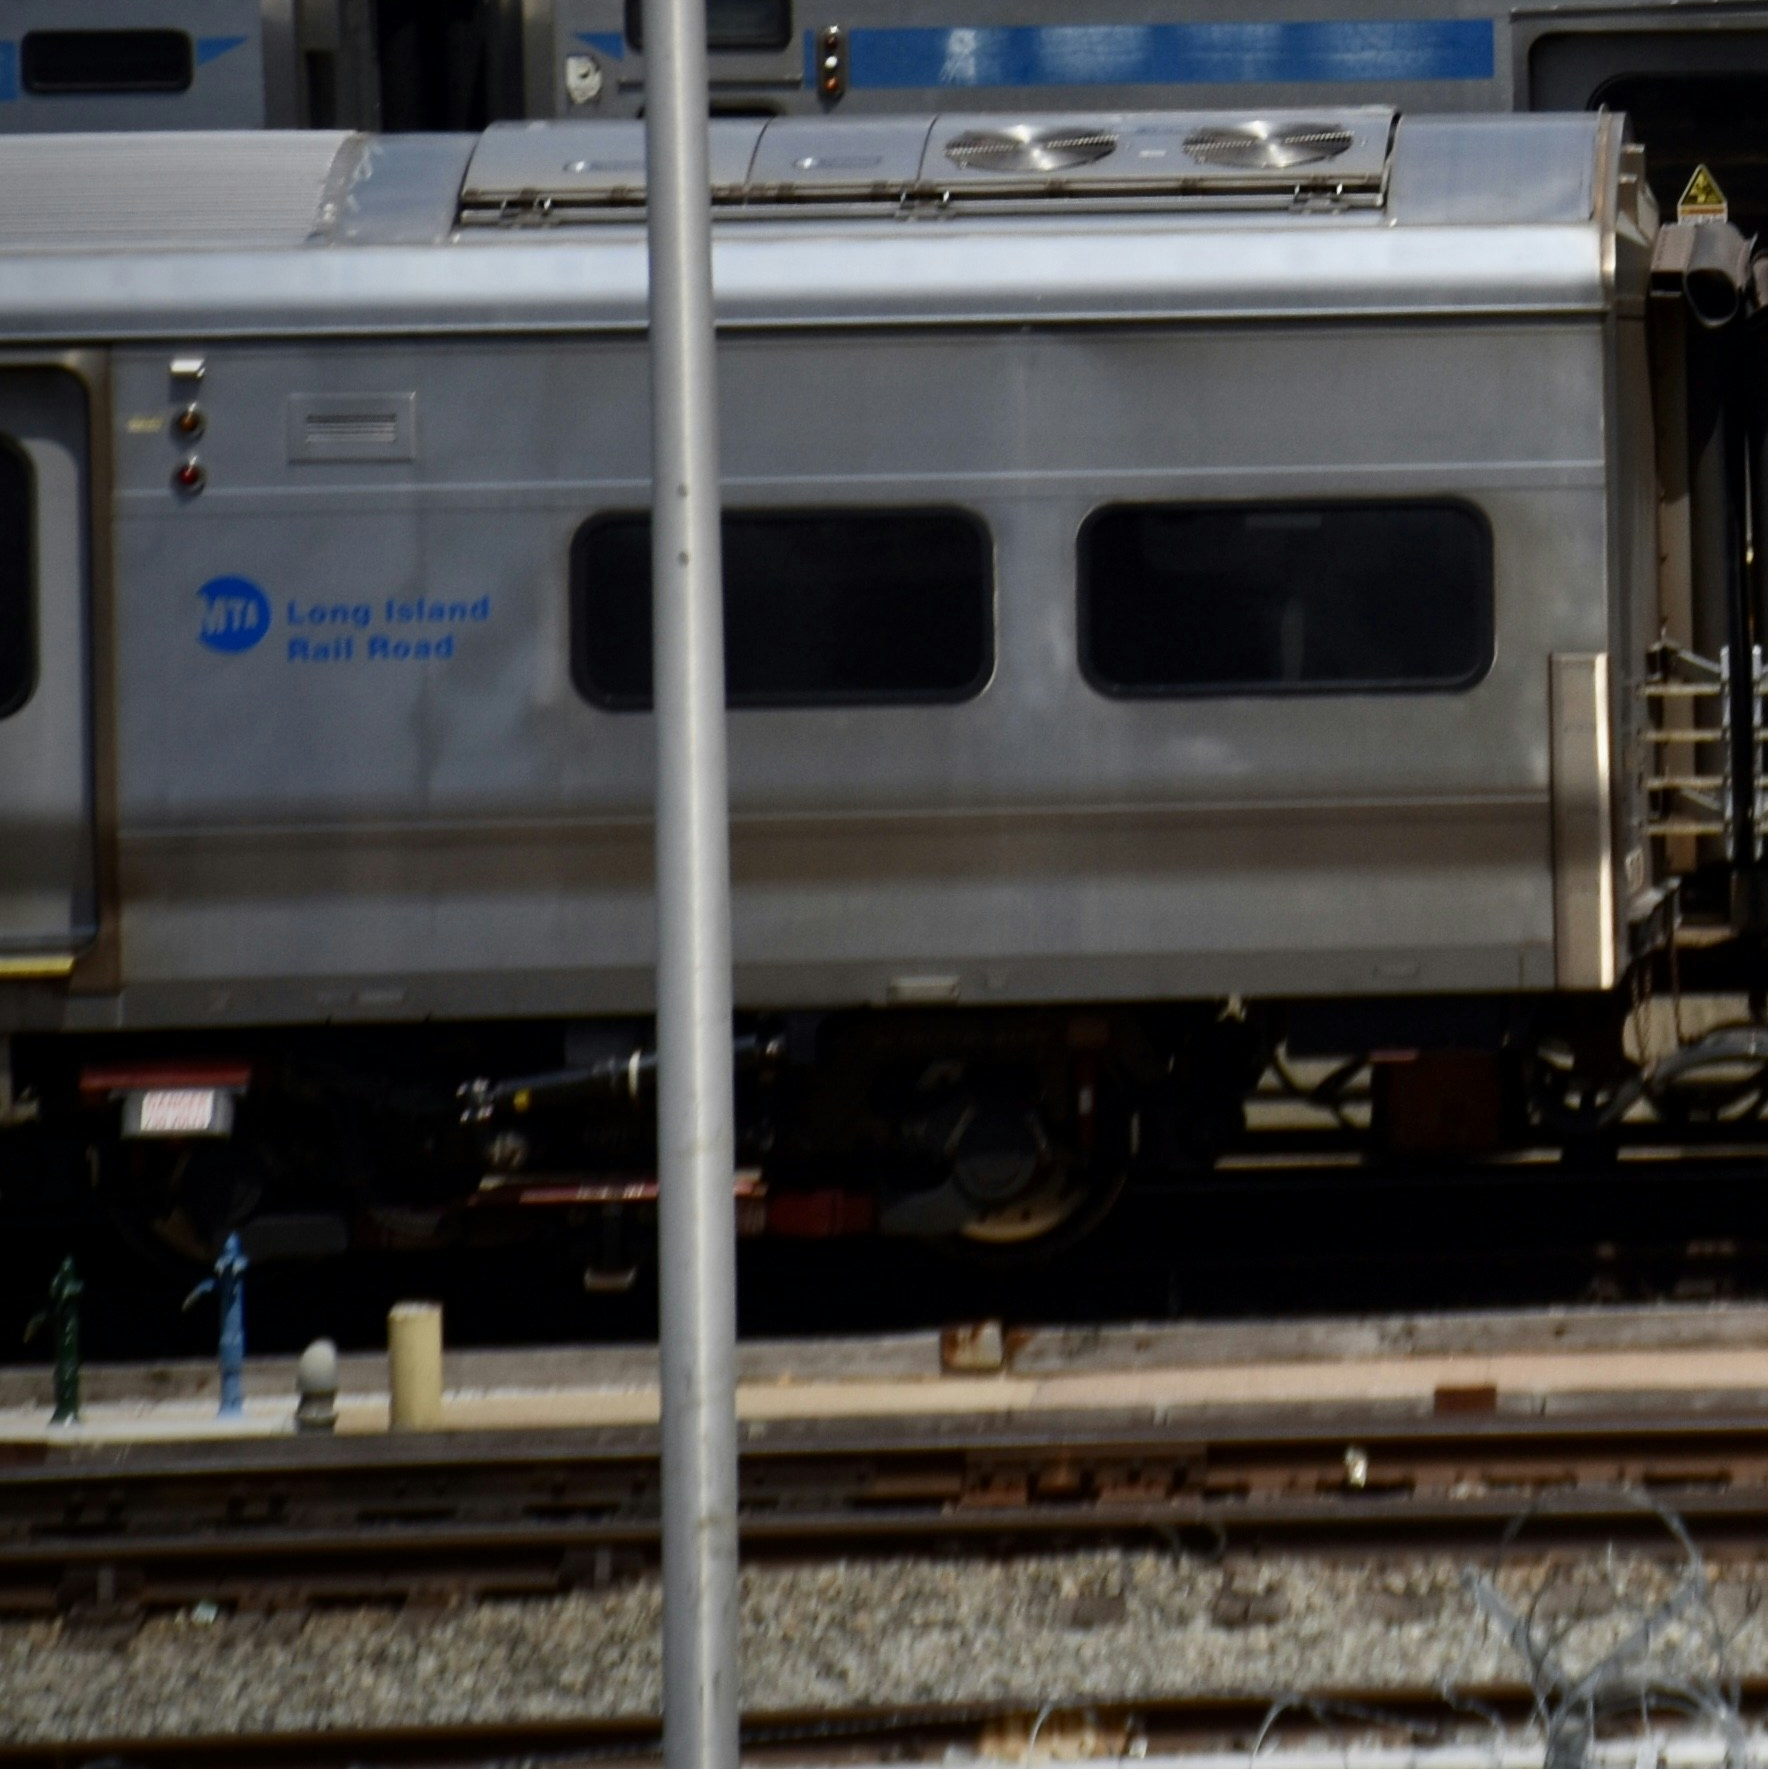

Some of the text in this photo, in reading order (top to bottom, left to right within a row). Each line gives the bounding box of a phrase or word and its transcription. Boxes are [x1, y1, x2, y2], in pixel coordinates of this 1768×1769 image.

[287, 600, 372, 628] Long
[385, 594, 491, 624] Island
[287, 634, 455, 662] Rail Road
